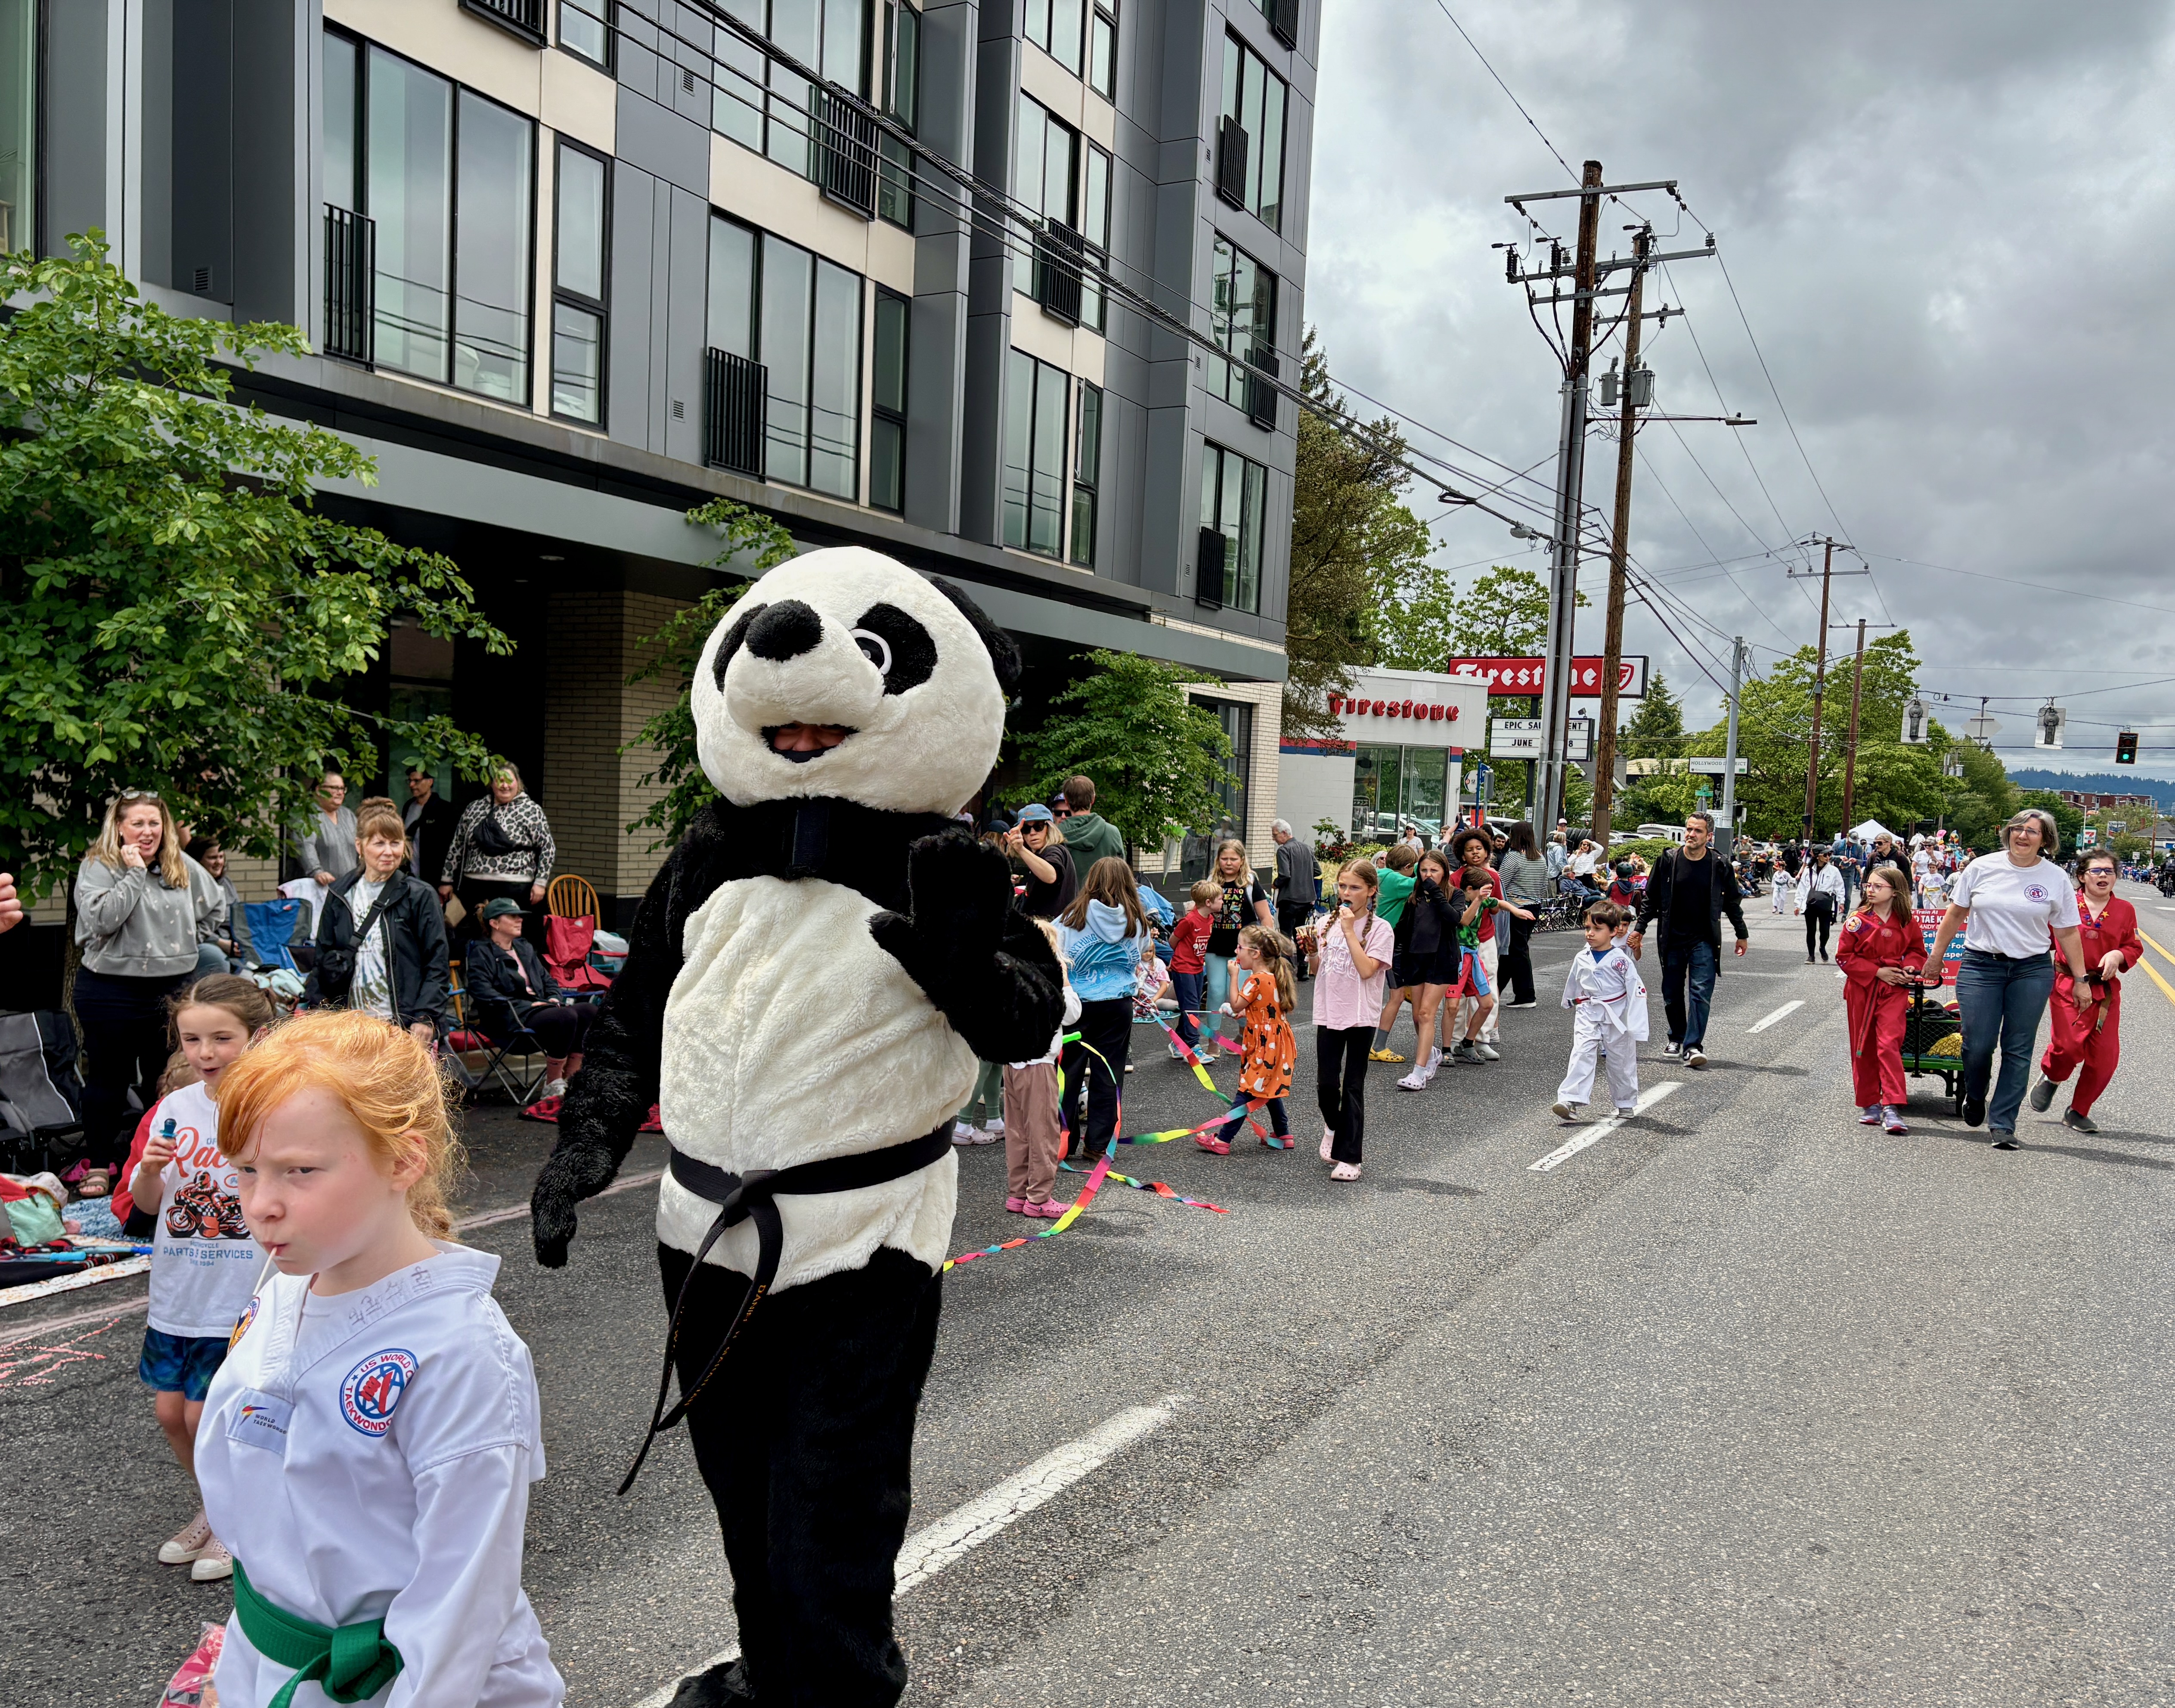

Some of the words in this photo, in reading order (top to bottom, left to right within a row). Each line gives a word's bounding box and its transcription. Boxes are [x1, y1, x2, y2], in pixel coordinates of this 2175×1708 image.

[1456, 663, 1597, 686] Firestne
[1327, 692, 1459, 721] Firestone
[1921, 915, 1935, 924] TAE
[164, 1247, 194, 1257] PARTS
[201, 1250, 253, 1259] SERVICES
[360, 1359, 377, 1373] US
[381, 1354, 411, 1369] WORLD
[255, 1414, 276, 1423] WORLD
[253, 1419, 287, 1434] TAEKWONDO
